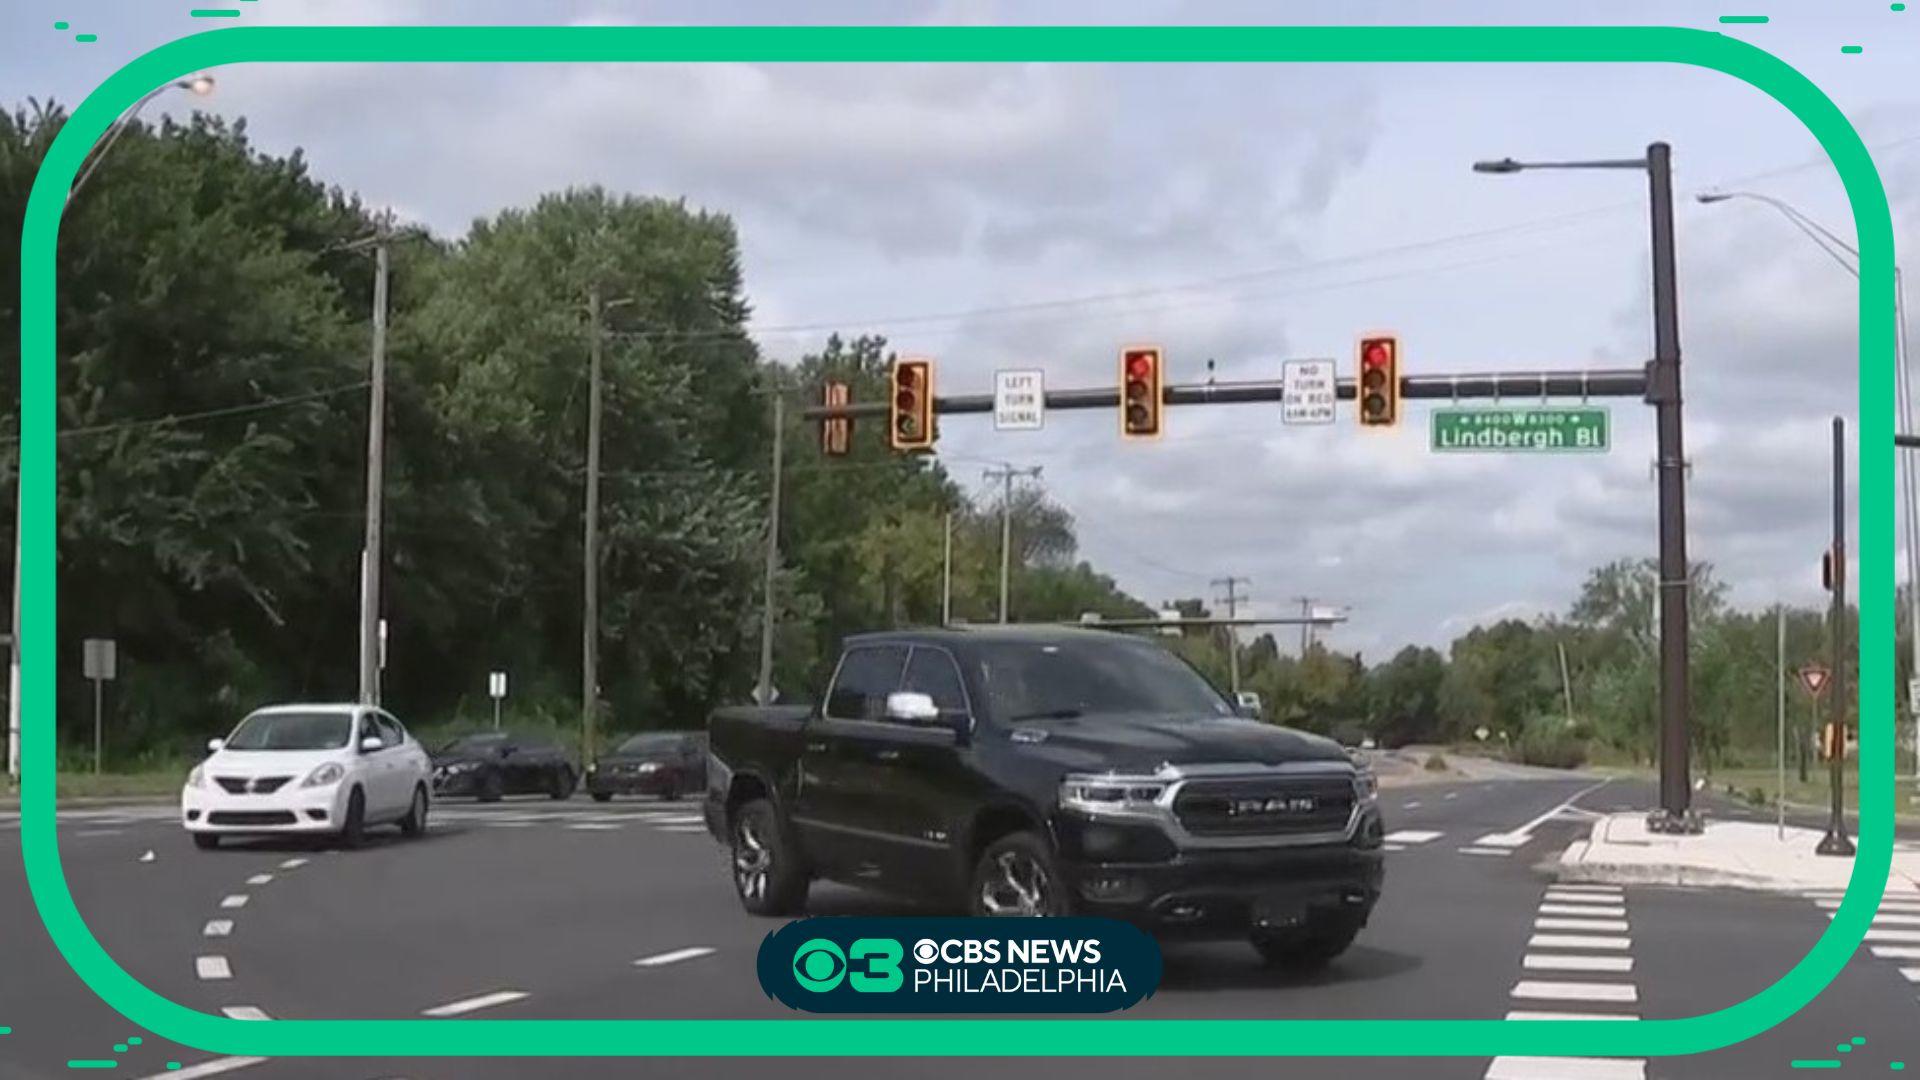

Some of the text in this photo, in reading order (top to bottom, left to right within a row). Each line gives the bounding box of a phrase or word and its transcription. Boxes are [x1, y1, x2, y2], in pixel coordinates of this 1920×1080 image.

[1300, 365, 1318, 375] NO
[1005, 376, 1032, 388] LEFT
[1294, 380, 1325, 390] TURN
[1005, 394, 1034, 405] TURN
[1286, 393, 1332, 405] ON RED
[1000, 412, 1036, 423] SIGNAL
[1440, 425, 1600, 449] Lindbergh Bl
